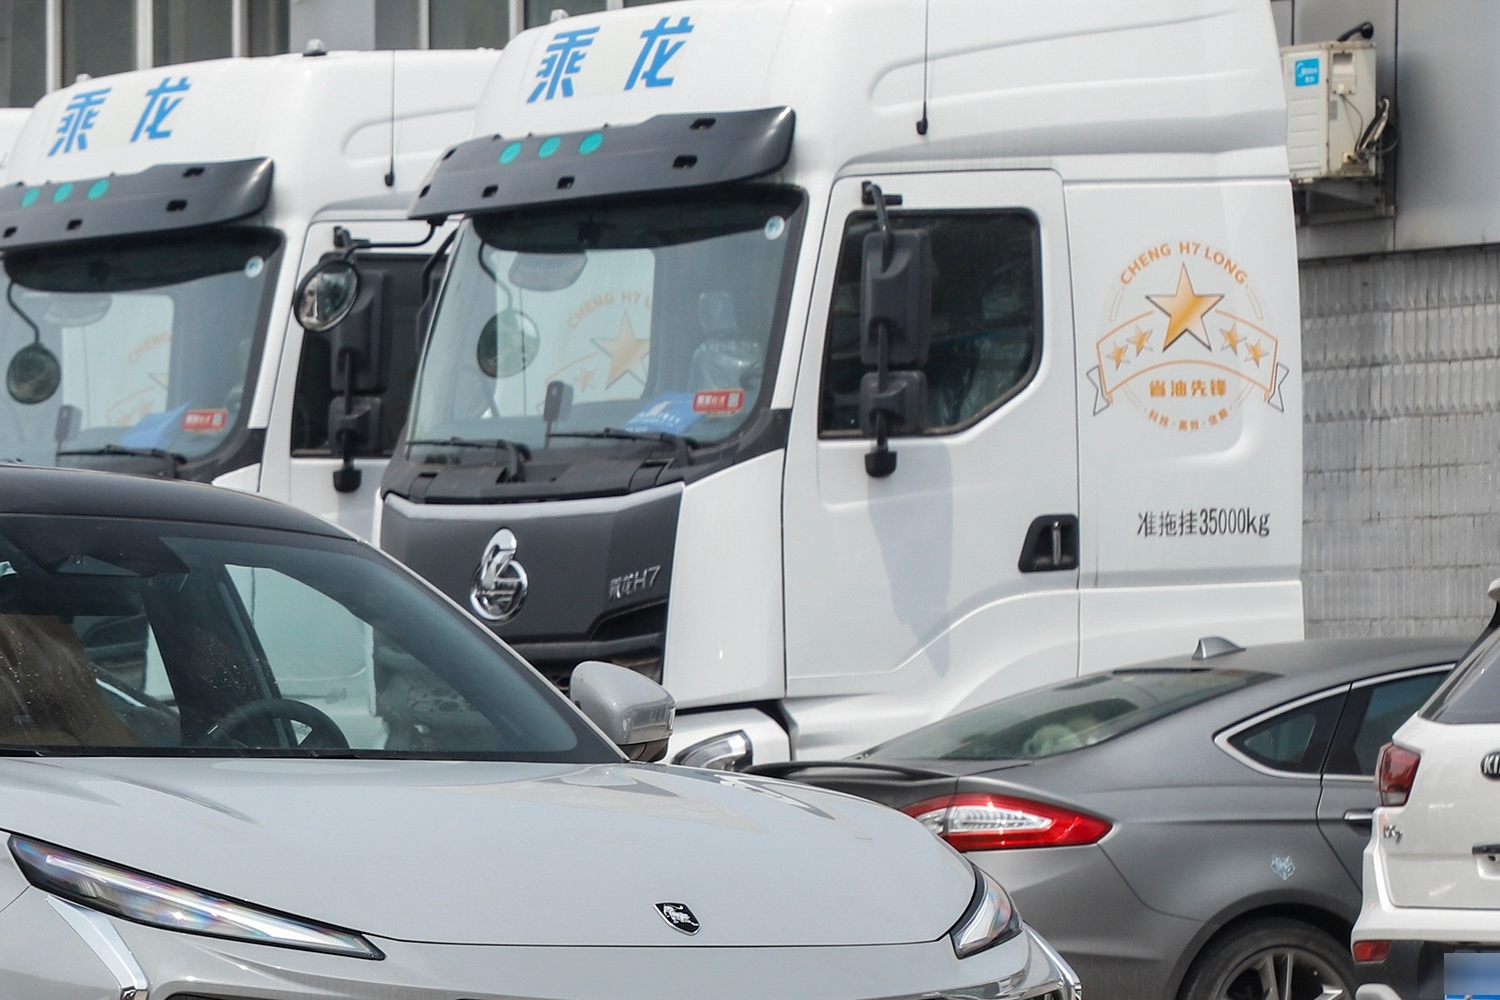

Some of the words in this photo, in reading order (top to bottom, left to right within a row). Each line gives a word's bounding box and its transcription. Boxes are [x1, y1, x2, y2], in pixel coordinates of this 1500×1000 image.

[526, 15, 695, 104] 乘龙
[48, 76, 192, 157] 乘龙
[1120, 242, 1171, 285] CHENG
[1179, 241, 1201, 255] H7
[1204, 246, 1248, 285] LONG
[1137, 506, 1271, 538] 准拖挂35000kg
[1483, 754, 1500, 774] KI
